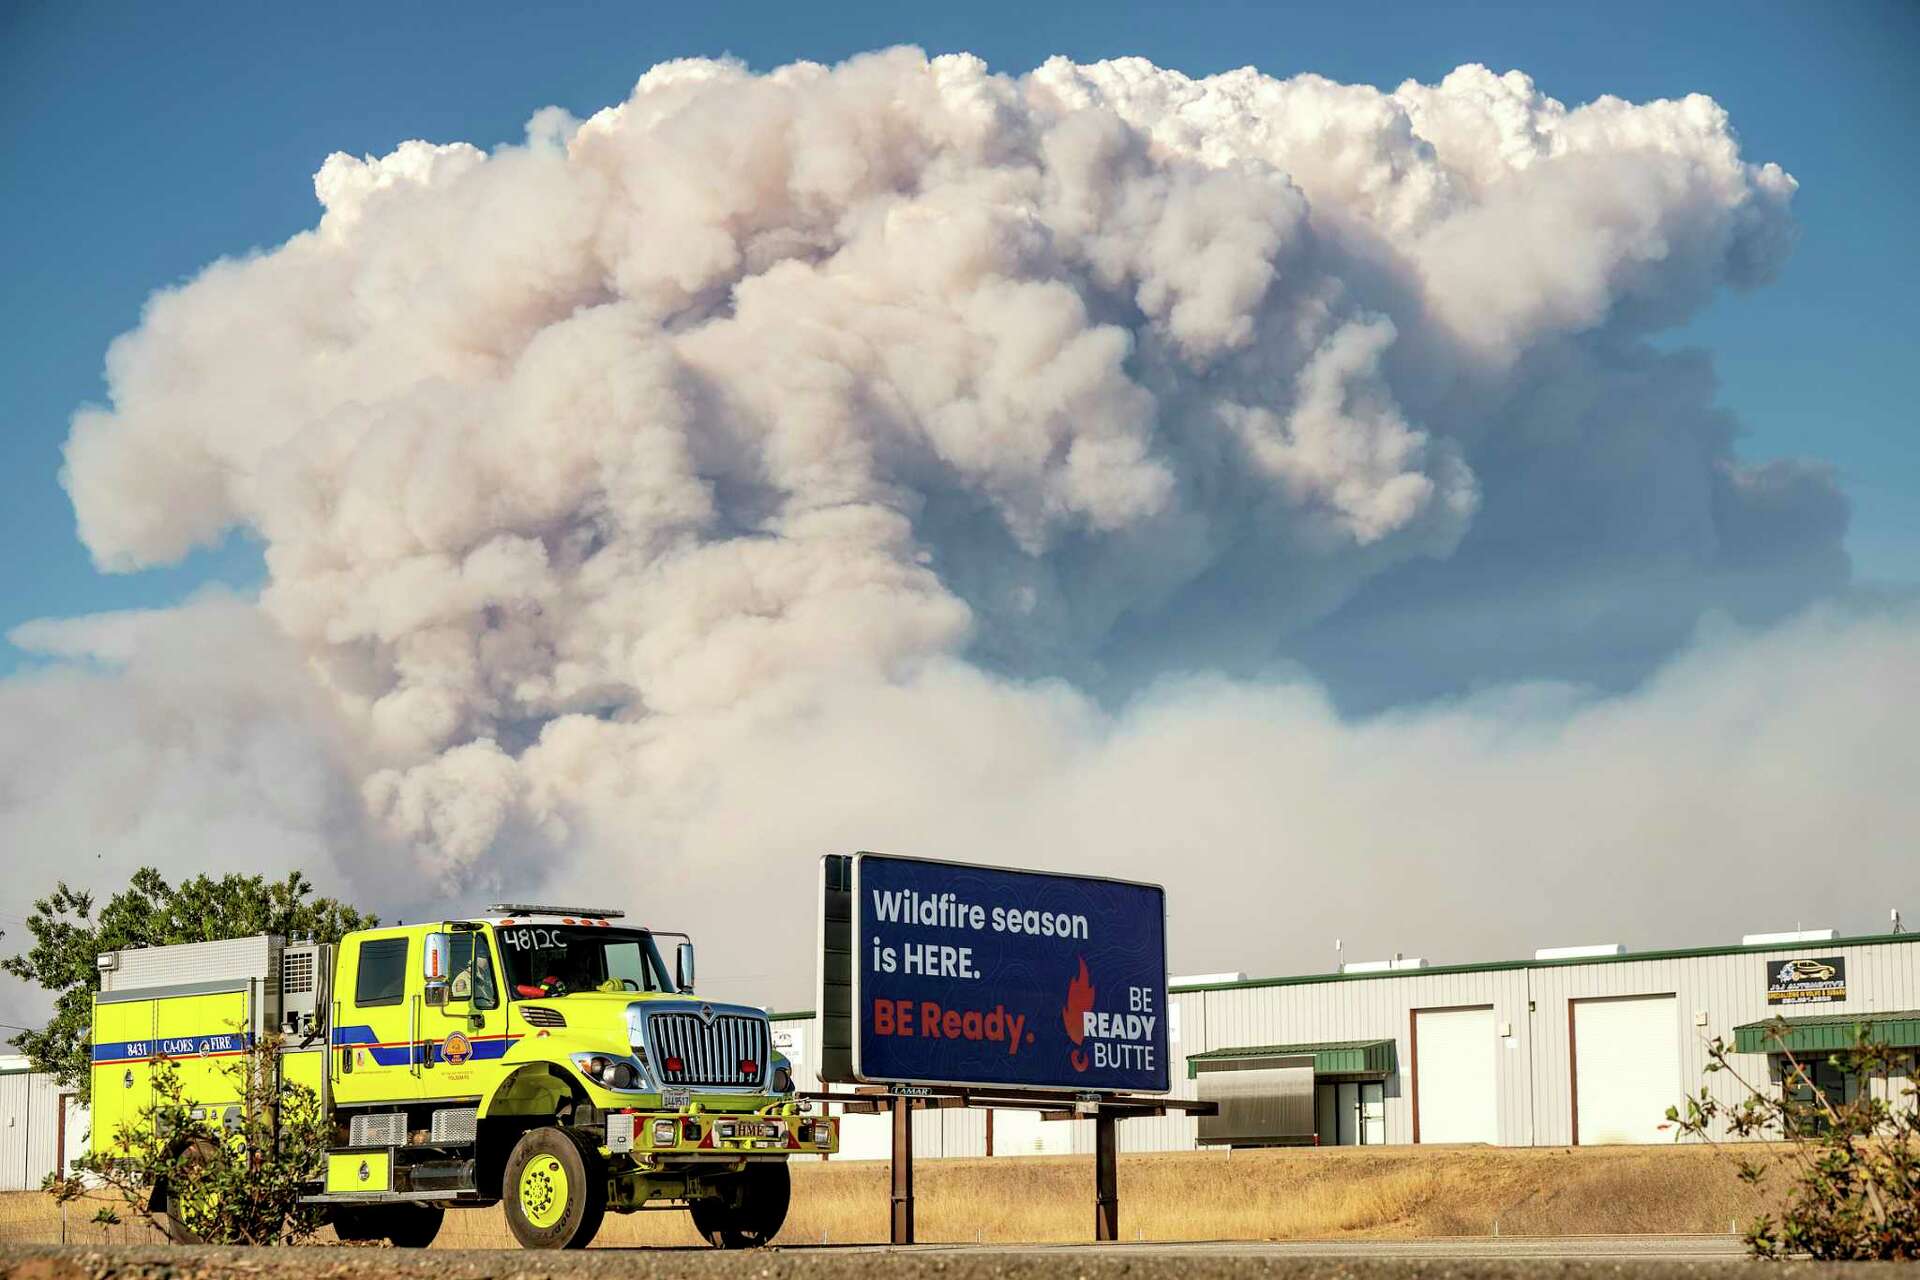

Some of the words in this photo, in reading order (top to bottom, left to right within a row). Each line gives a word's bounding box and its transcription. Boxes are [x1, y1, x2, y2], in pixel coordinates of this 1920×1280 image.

[872, 888, 985, 930] Wildfire
[991, 905, 1089, 940] season
[503, 928, 568, 952] 4812C
[873, 936, 897, 973] is
[904, 943, 981, 980] HERE.
[1129, 986, 1153, 1013] BE
[874, 998, 913, 1037] BE
[921, 1001, 1036, 1055] Ready.
[1083, 1011, 1156, 1041] READY
[127, 1042, 147, 1056] 8431
[163, 1039, 194, 1053] CA-OES
[210, 1036, 232, 1050] FIRE
[1094, 1042, 1155, 1071] BUTTE
[894, 1087, 928, 1096] LAMAR
[736, 1122, 763, 1137] HME
